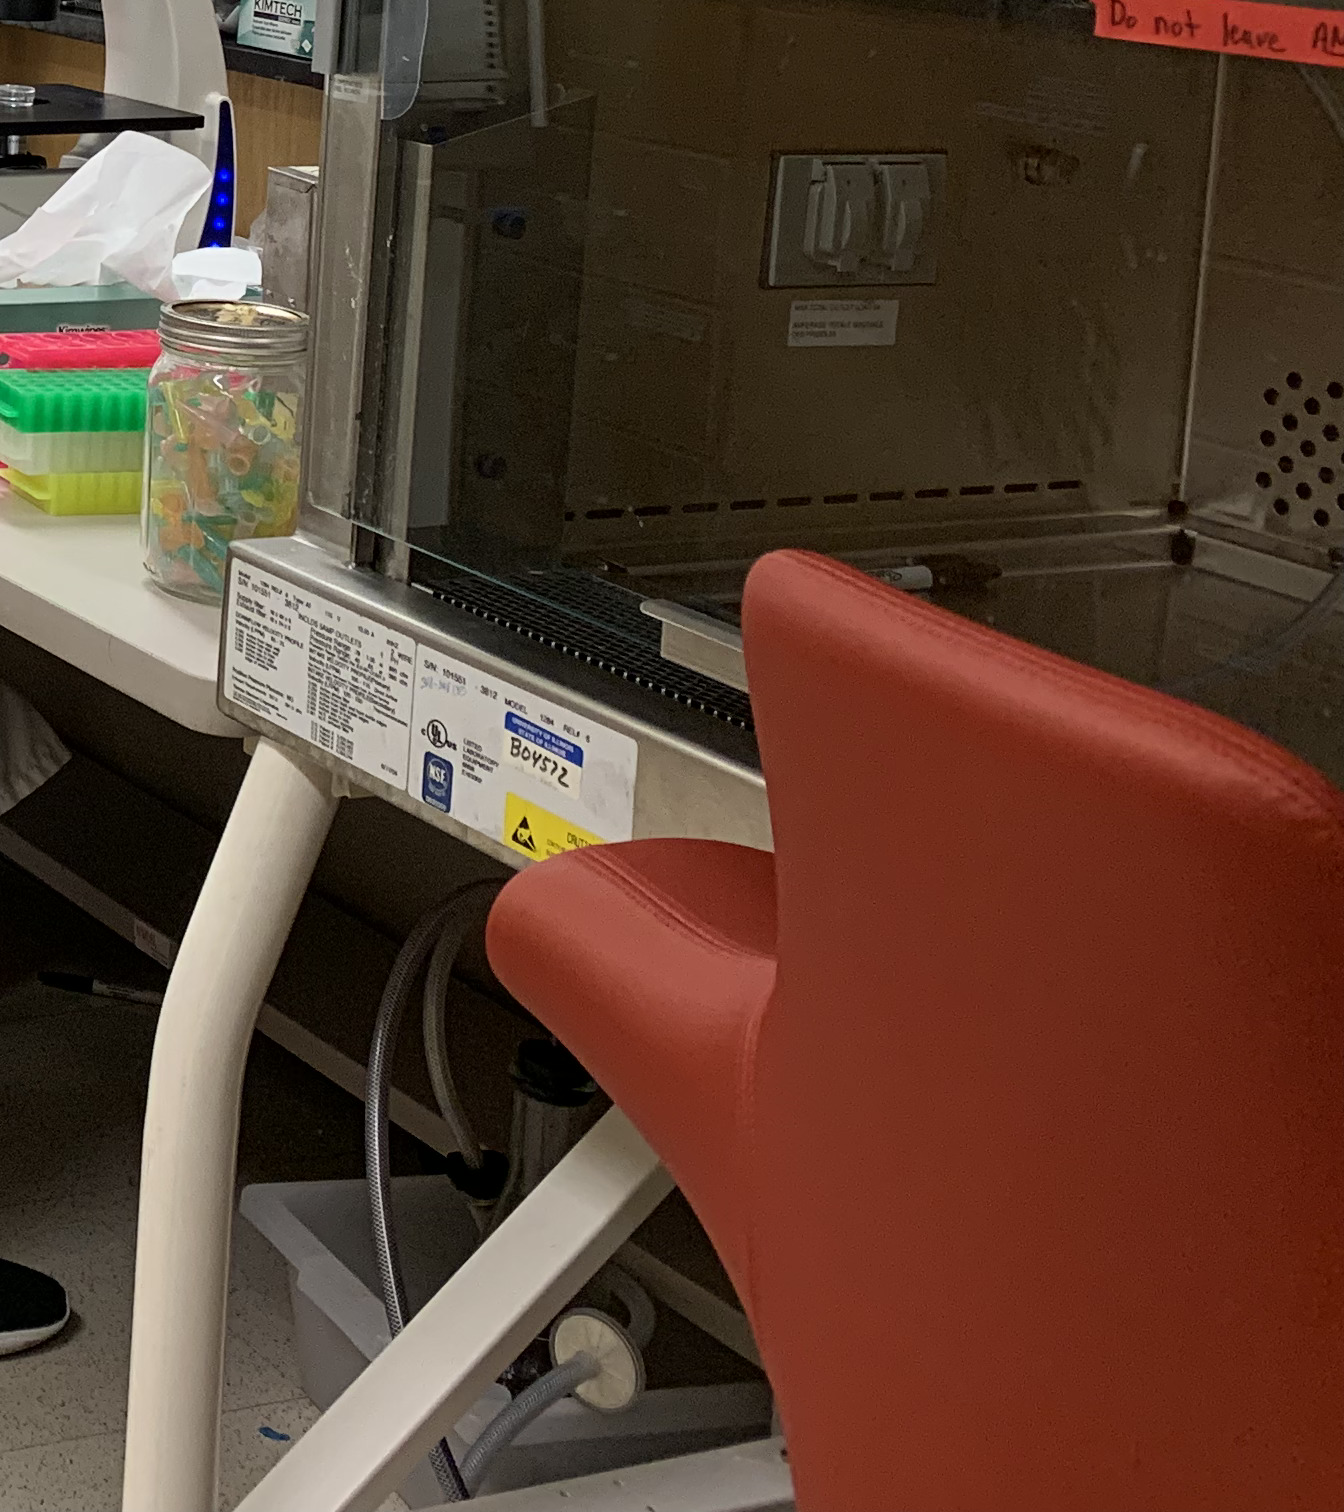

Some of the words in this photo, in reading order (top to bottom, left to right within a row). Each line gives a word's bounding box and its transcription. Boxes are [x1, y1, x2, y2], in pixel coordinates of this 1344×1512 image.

[1154, 9, 1202, 38] not
[1222, 11, 1287, 53] leave
[480, 685, 498, 701] 3812
[504, 697, 527, 715] MODEL
